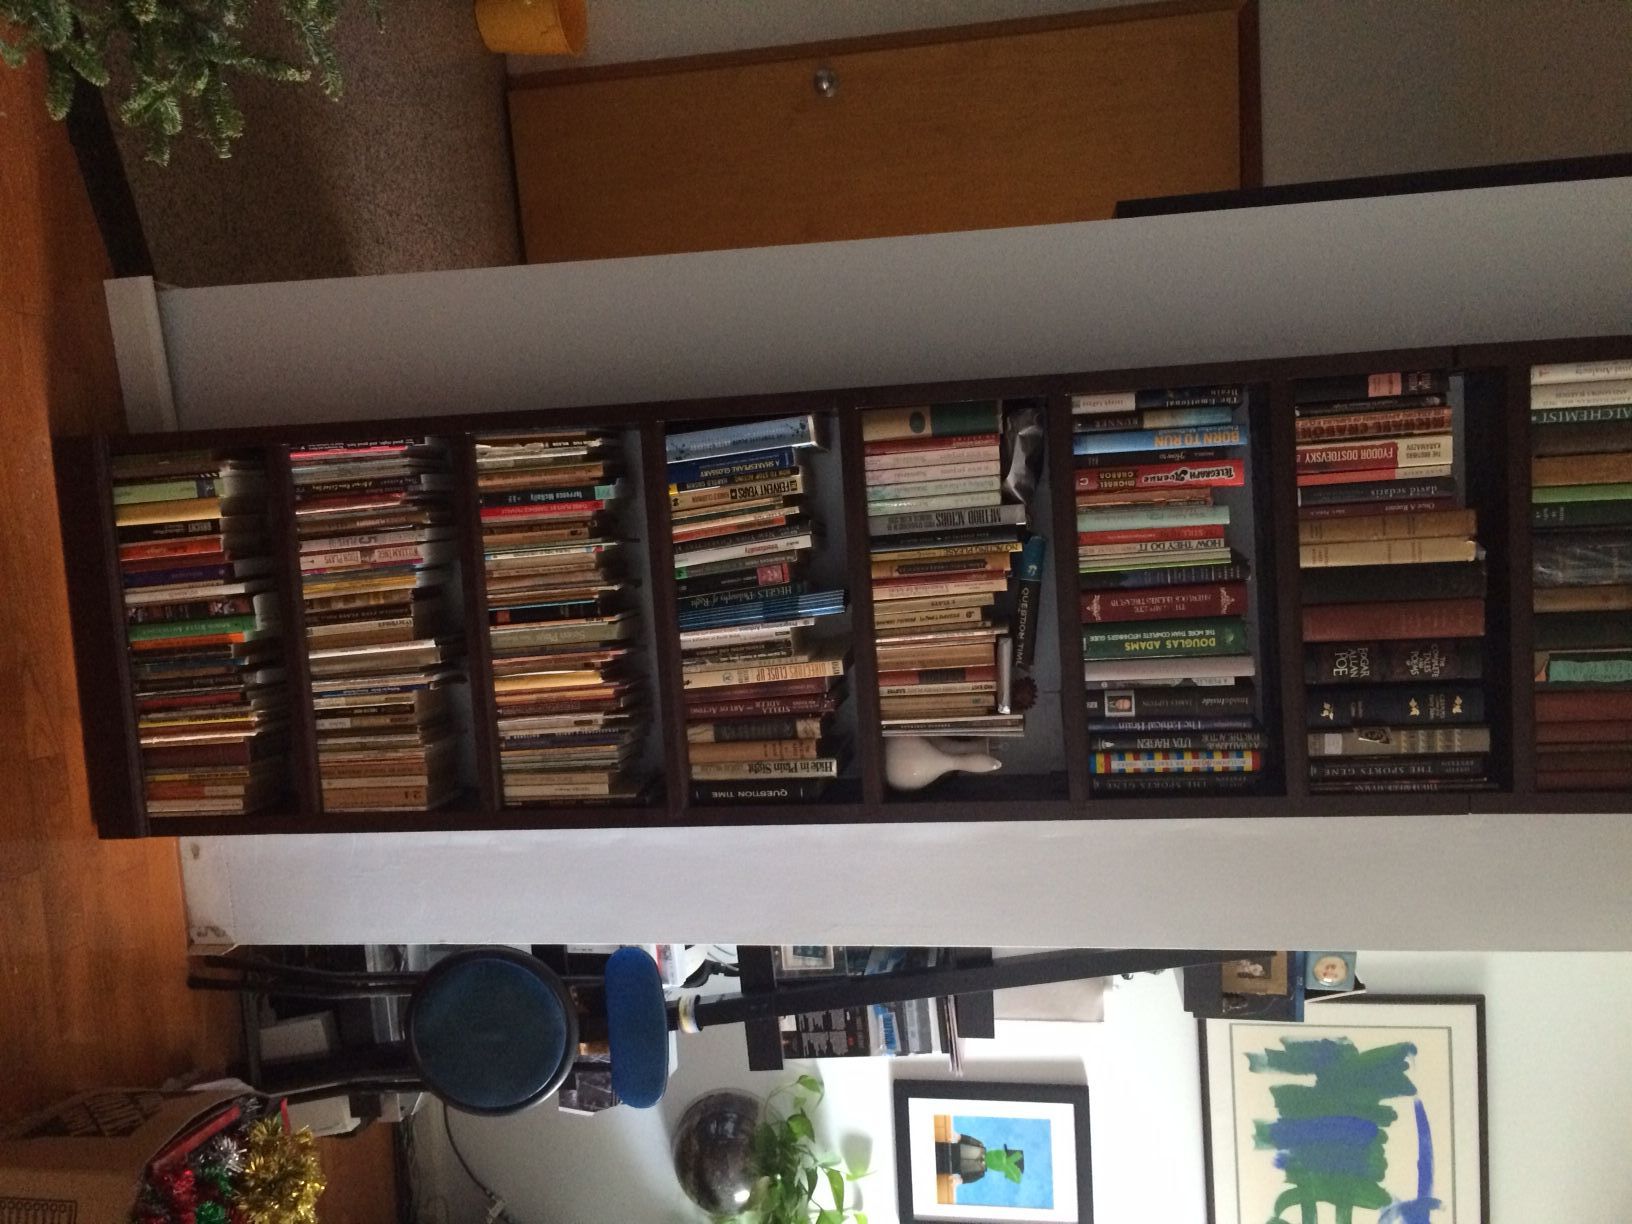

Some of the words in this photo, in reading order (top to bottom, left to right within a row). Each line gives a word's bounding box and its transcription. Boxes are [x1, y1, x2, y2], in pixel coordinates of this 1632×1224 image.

[1166, 398, 1216, 407] Emotional
[1543, 408, 1631, 423] ALCHEMIST
[1154, 434, 1182, 448] RUN
[1184, 434, 1200, 446] TO
[1203, 432, 1240, 445] BORN
[1406, 442, 1440, 451] KARAMAZOV
[1305, 449, 1358, 463] DOSTOEVSKY
[1360, 446, 1393, 459] FYODOR
[731, 460, 774, 471] SHAKESPEARE
[699, 466, 731, 477] GLOSSARY
[754, 472, 769, 480] STOP
[736, 486, 758, 499] YEARS
[759, 482, 790, 497] FERVENT
[1371, 486, 1406, 498] sedaris
[1410, 484, 1437, 496] david
[530, 493, 555, 502] McNally
[1385, 504, 1408, 512] Runner
[935, 511, 965, 527] ACTORS
[967, 508, 1001, 525] METHOD
[945, 546, 972, 554] PLEASE
[975, 544, 1002, 552] ACTING
[1137, 543, 1148, 551] IT
[1150, 542, 1165, 550] DO
[1167, 541, 1192, 551] THEY
[1196, 540, 1221, 549] HOW
[324, 553, 343, 564] PLAYS
[392, 547, 418, 559] WILLIAM
[719, 590, 754, 604] Philosophy
[1018, 587, 1029, 639] QUESTION
[1089, 634, 1106, 642] GUIDE
[1143, 631, 1170, 639] COMPLETE
[1170, 630, 1186, 638] THAN
[1124, 639, 1161, 651] ADAMS
[1166, 637, 1216, 649] DOUGLAS
[1333, 651, 1350, 676] POE
[1350, 649, 1359, 678] ALLAN
[1357, 647, 1370, 678] EDGAR
[756, 668, 766, 681] UP
[767, 666, 788, 680] CLOSE
[787, 663, 826, 677] DIRECTORS
[755, 700, 780, 708] ADLER
[762, 705, 791, 714] STELLA
[1119, 723, 1145, 732] Brain
[1147, 721, 1181, 732] Ethical
[1184, 720, 1201, 731] The
[1137, 738, 1169, 749] HAGEN
[1171, 738, 1191, 749] UTA
[748, 762, 772, 774] Sight
[773, 763, 797, 773] Plain
[800, 762, 809, 772] in
[811, 761, 833, 772] Hide
[1324, 768, 1355, 776] GENE
[1360, 766, 1405, 774] SPORTS
[1410, 765, 1431, 773] THE
[737, 788, 788, 797] QUESTION
